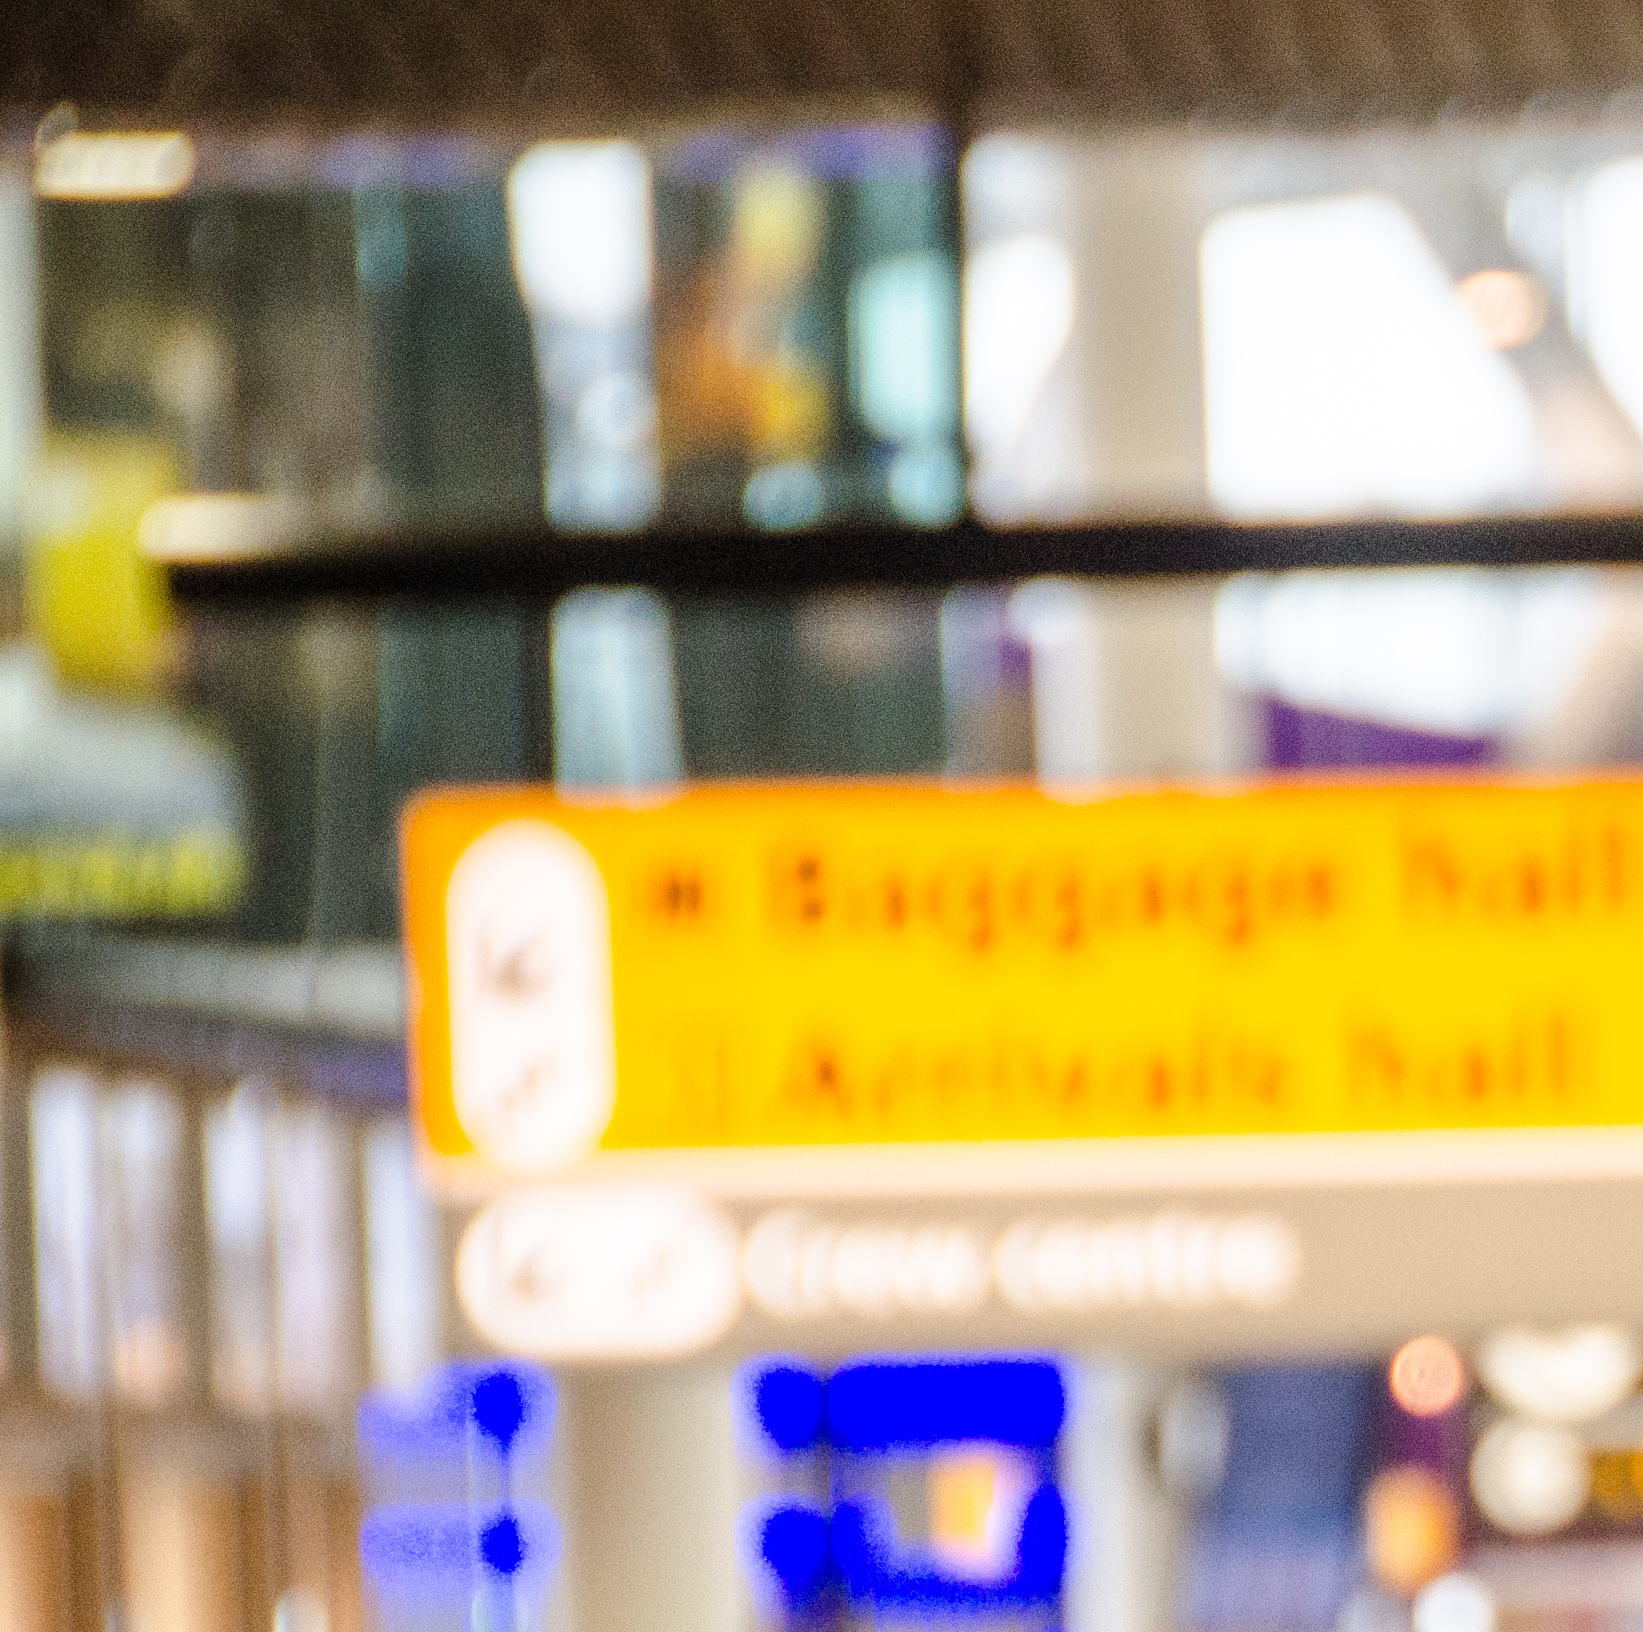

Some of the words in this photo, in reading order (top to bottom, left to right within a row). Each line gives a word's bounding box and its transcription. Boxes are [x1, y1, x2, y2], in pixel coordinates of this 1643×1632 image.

[766, 834, 1345, 956] Baggage
[774, 1025, 1290, 1118] Arrivals
[1342, 1003, 1588, 1110] hall
[742, 1207, 987, 1319] Crew
[989, 1207, 1301, 1312] centre
